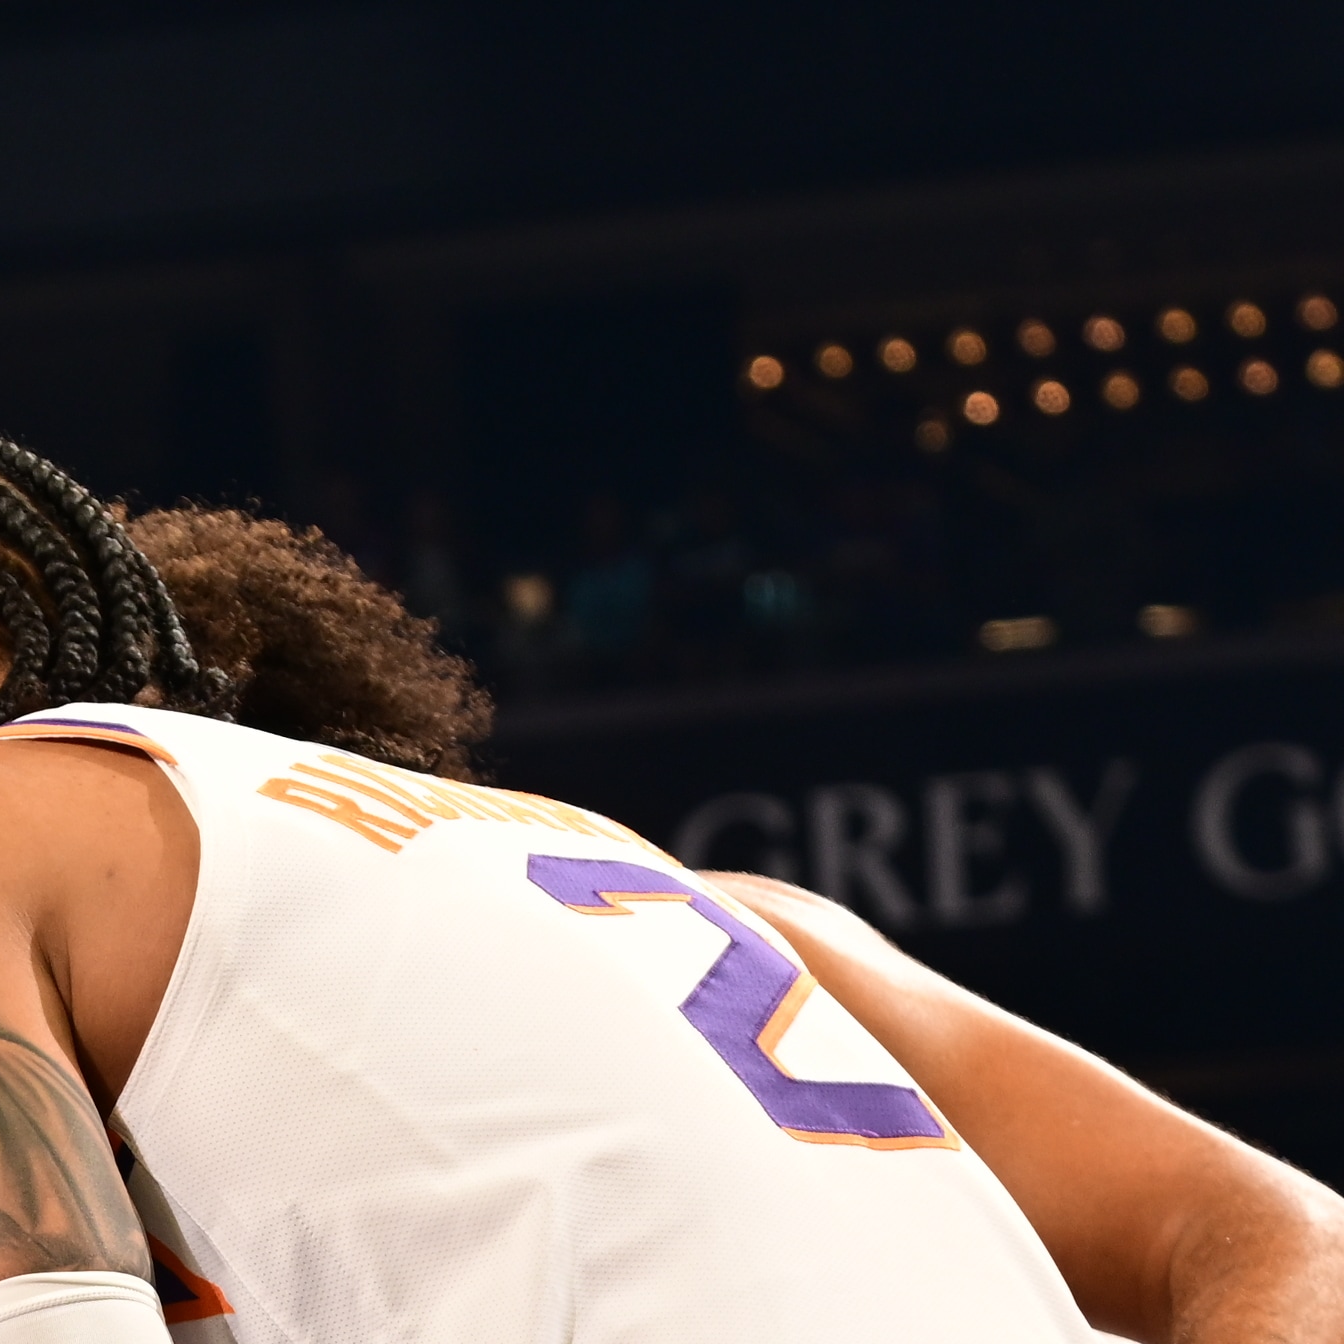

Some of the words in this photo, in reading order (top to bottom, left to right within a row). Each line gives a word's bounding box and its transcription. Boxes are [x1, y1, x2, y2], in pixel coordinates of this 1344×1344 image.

[670, 757, 1141, 928] GREY
[1189, 740, 1344, 902] G
[526, 853, 960, 1150] 2
